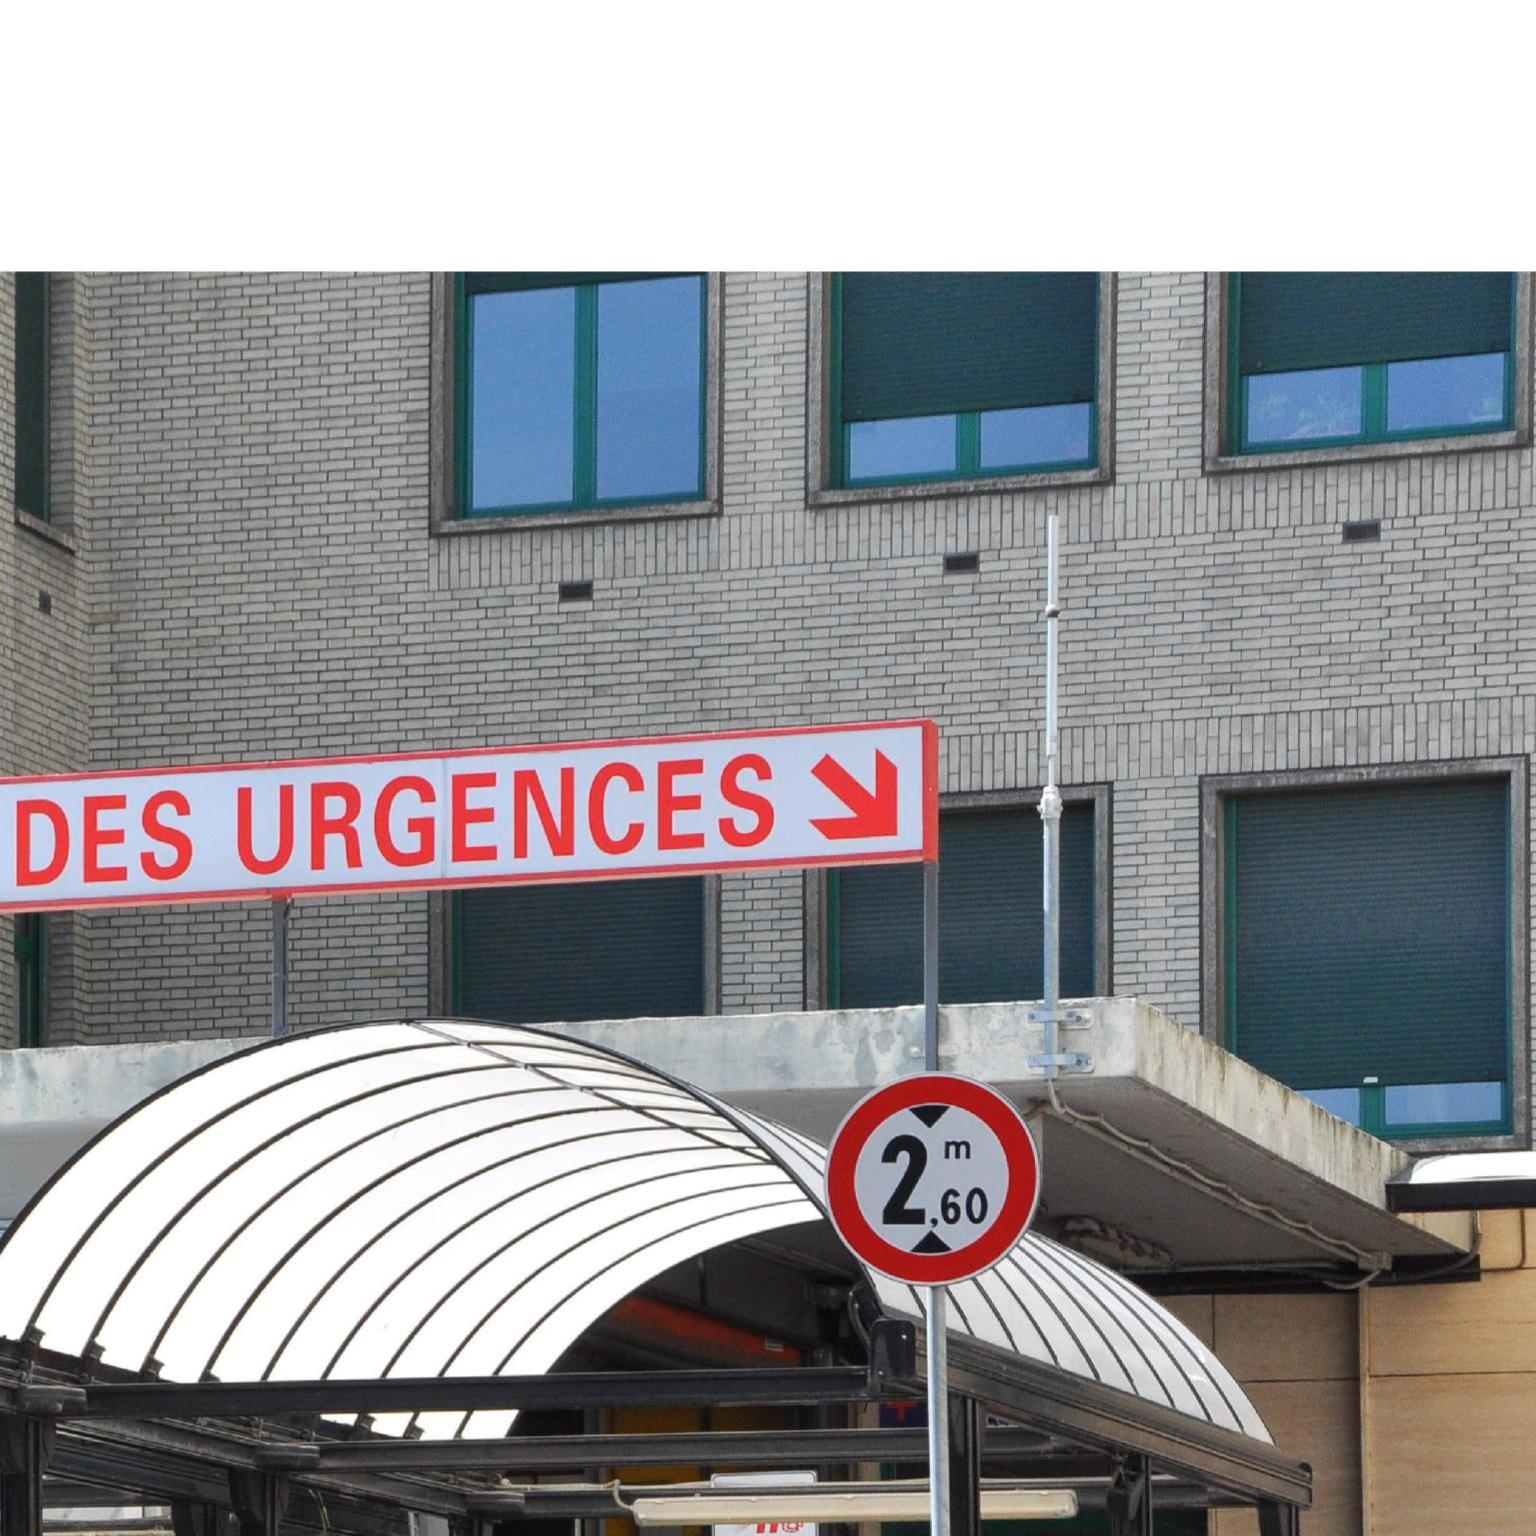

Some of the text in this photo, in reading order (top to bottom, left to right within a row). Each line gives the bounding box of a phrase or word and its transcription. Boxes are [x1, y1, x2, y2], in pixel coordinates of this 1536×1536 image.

[17, 791, 192, 886] DES
[238, 754, 774, 874] URGENCES
[944, 1140, 971, 1159] m
